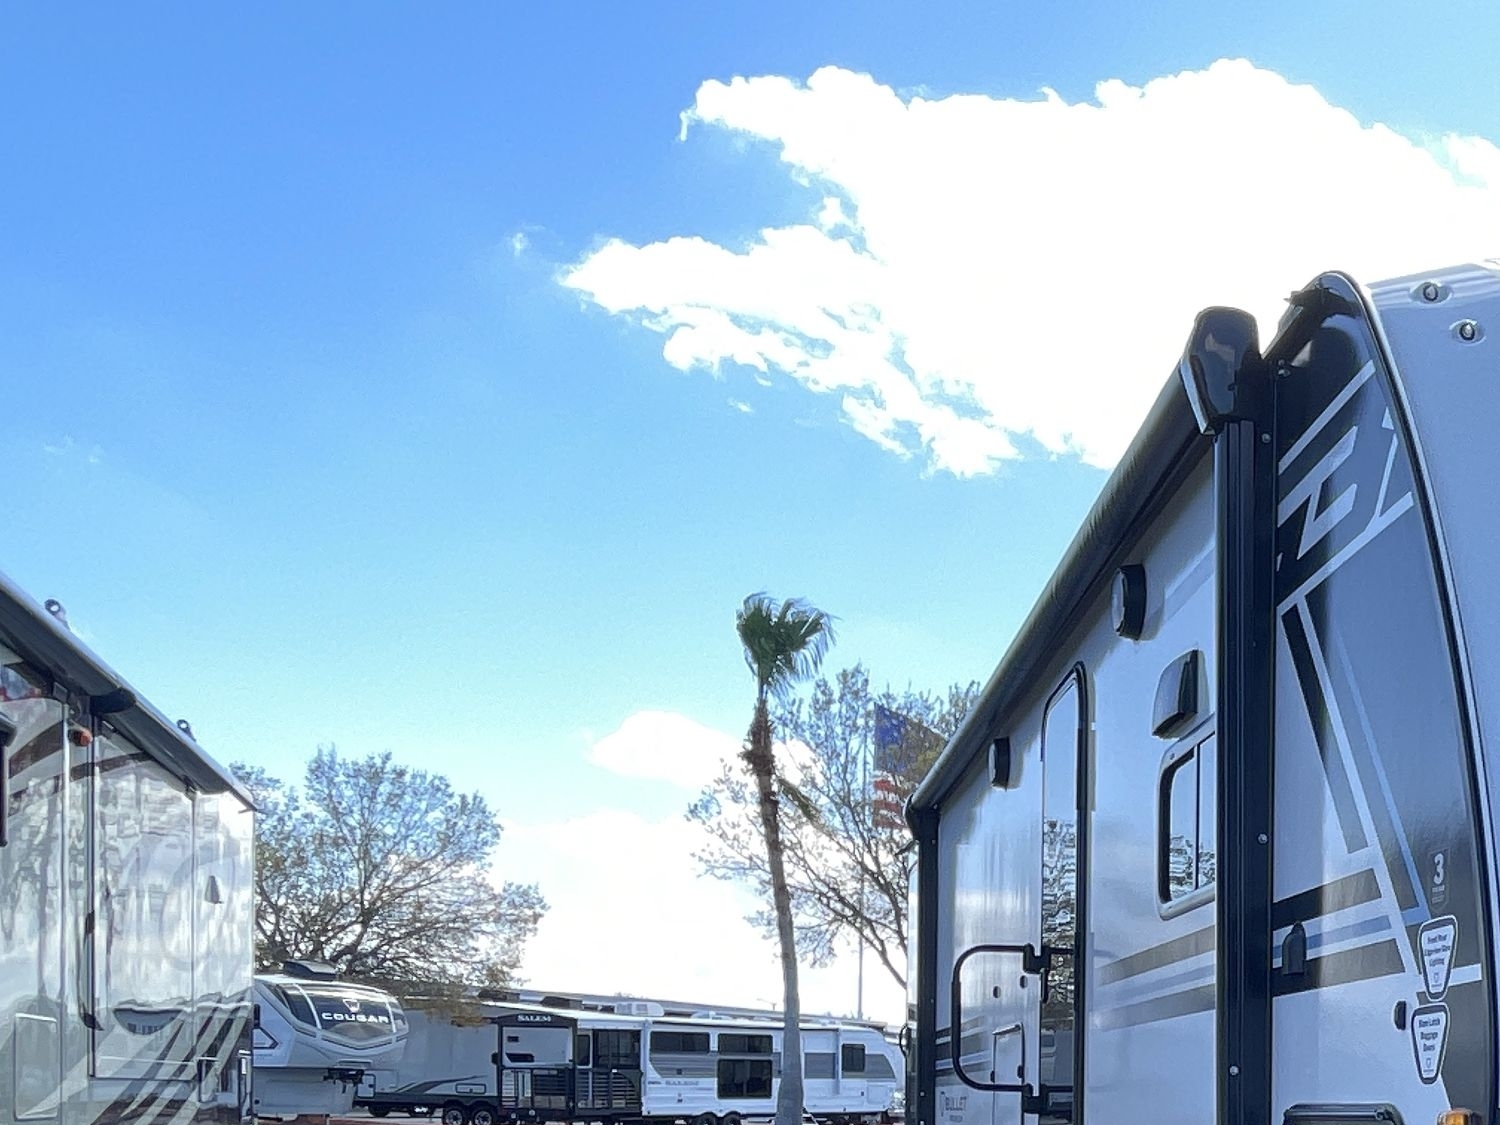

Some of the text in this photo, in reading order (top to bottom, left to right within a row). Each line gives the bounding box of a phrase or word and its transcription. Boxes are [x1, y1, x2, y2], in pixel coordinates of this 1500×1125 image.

[1433, 853, 1444, 885] 3
[321, 1012, 389, 1024] COUGAR
[517, 1014, 552, 1022] SALEM
